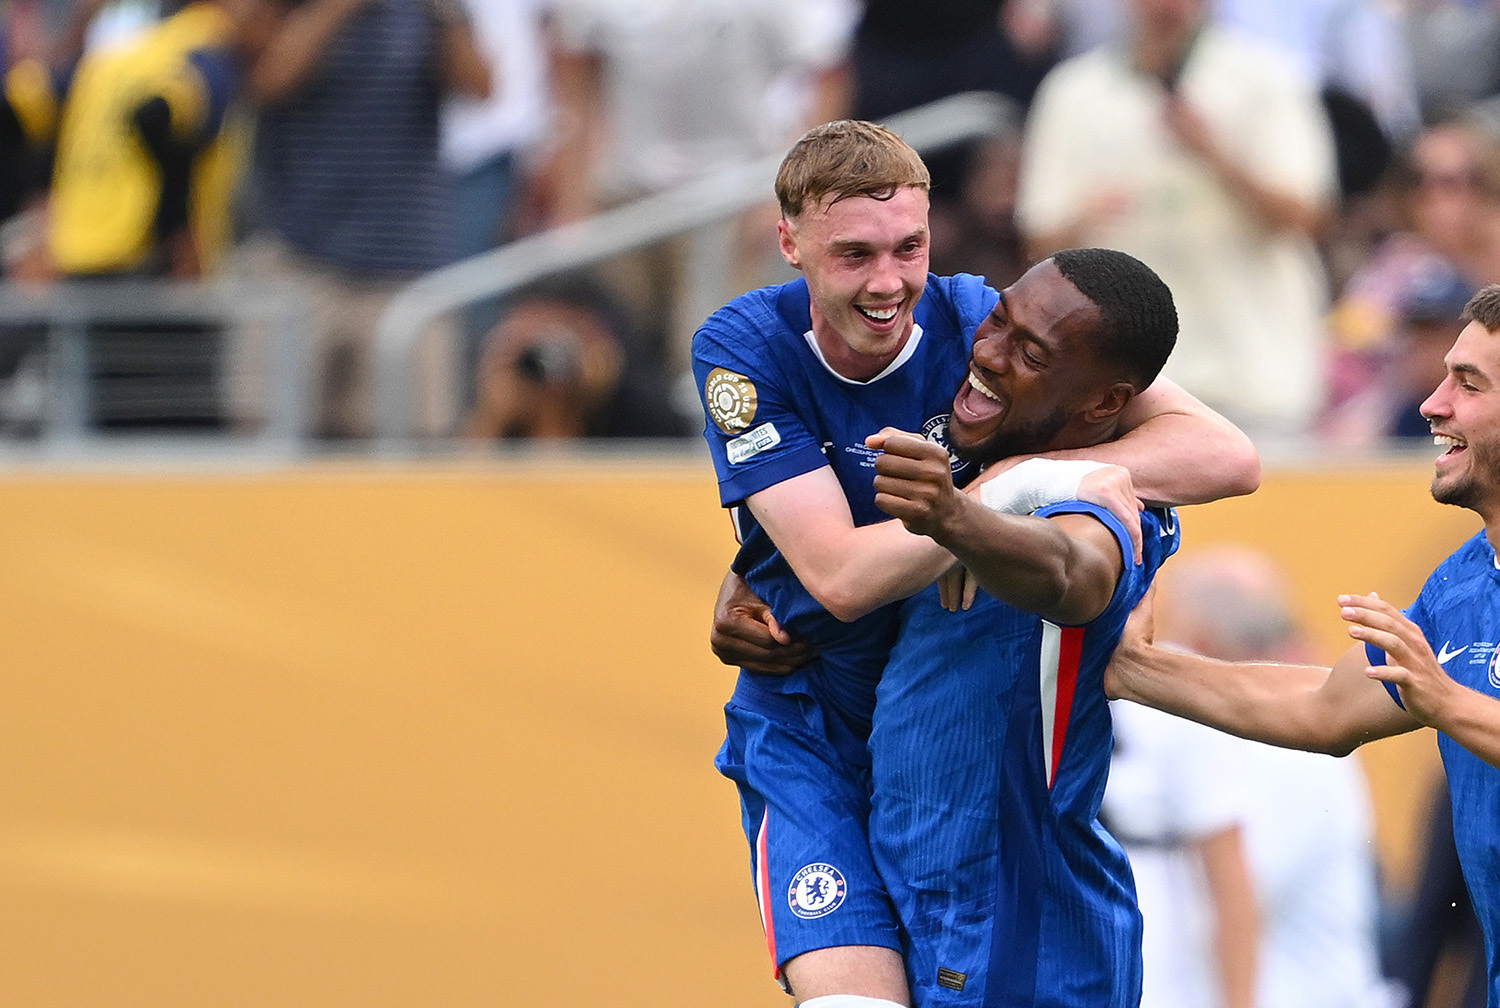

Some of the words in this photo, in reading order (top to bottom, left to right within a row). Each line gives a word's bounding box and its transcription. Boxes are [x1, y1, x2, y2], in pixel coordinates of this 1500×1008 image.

[708, 374, 722, 399] WORLD
[723, 372, 739, 383] CUP
[796, 865, 835, 881] CHELSEA
